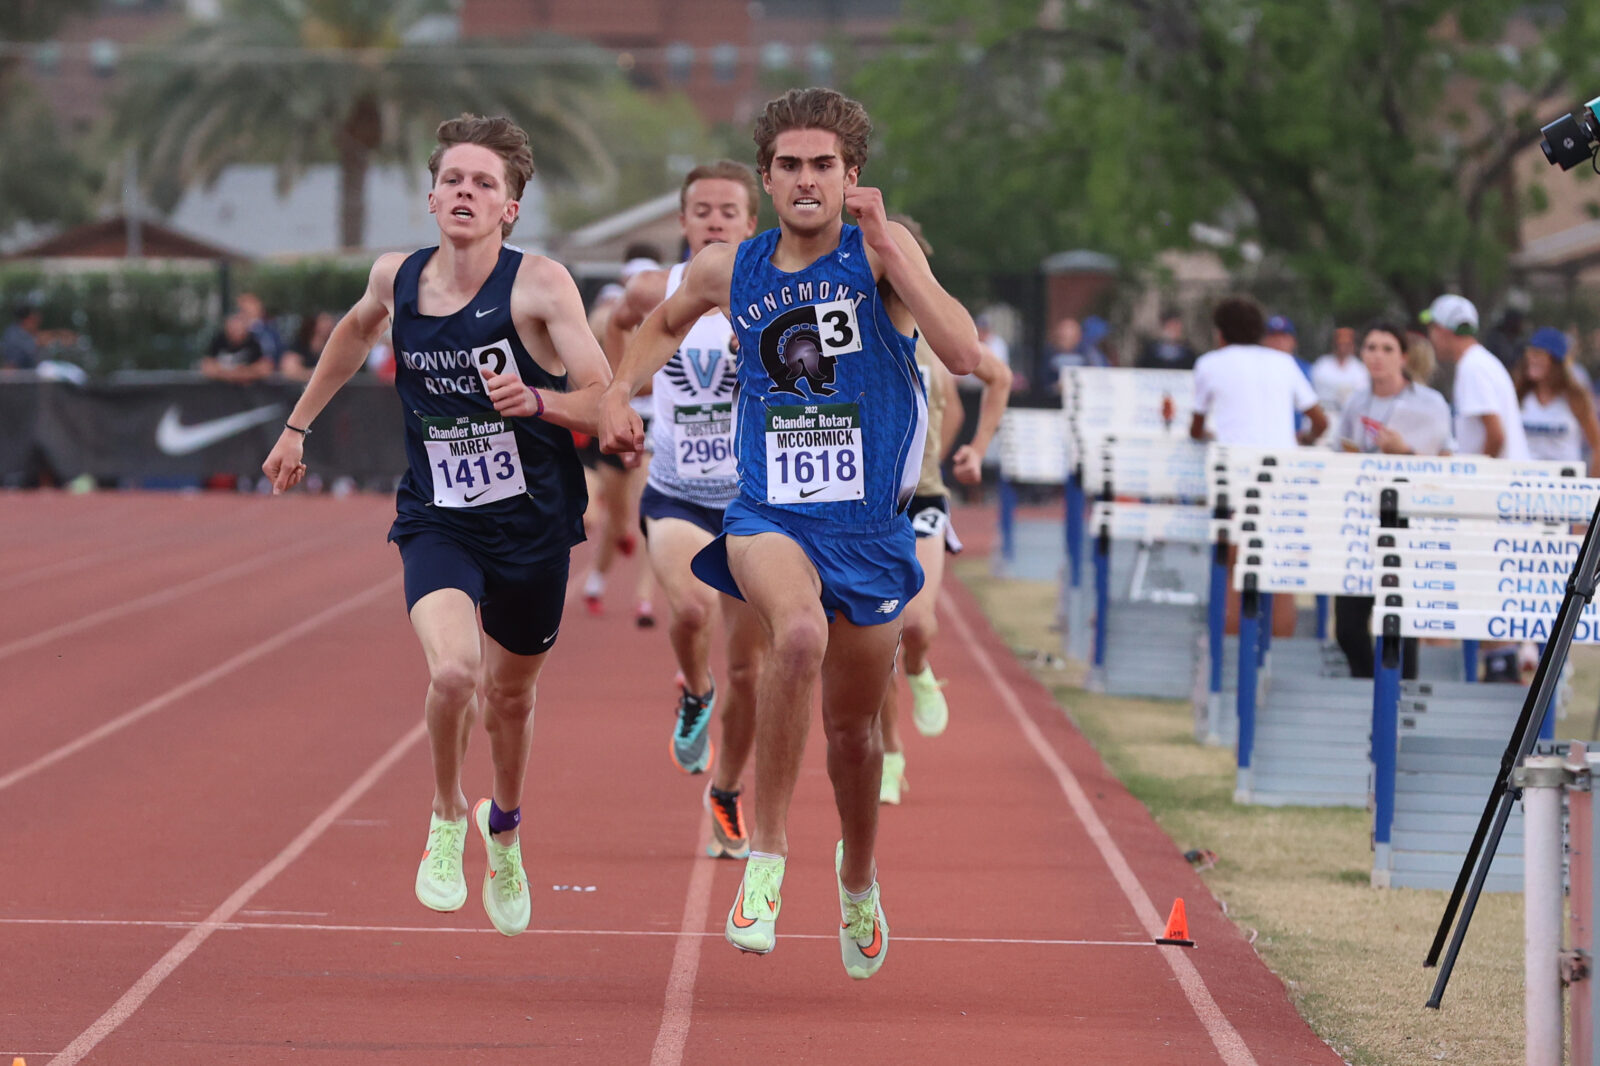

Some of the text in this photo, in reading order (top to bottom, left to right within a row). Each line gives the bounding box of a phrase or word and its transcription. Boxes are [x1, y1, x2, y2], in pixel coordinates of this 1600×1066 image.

[737, 281, 868, 330] LONGMONT
[821, 310, 854, 348] 3
[687, 348, 722, 389] V
[424, 375, 480, 395] RIDGE
[805, 406, 818, 414] 2022
[428, 420, 505, 439] Chandler Rotary
[456, 416, 470, 425] 2022
[772, 414, 853, 429] Chandler Rotary
[449, 437, 493, 457] MAREK
[777, 430, 854, 448] MCCORMICK
[680, 437, 731, 464] 296
[437, 450, 515, 489] 1413
[775, 449, 857, 484] 1618
